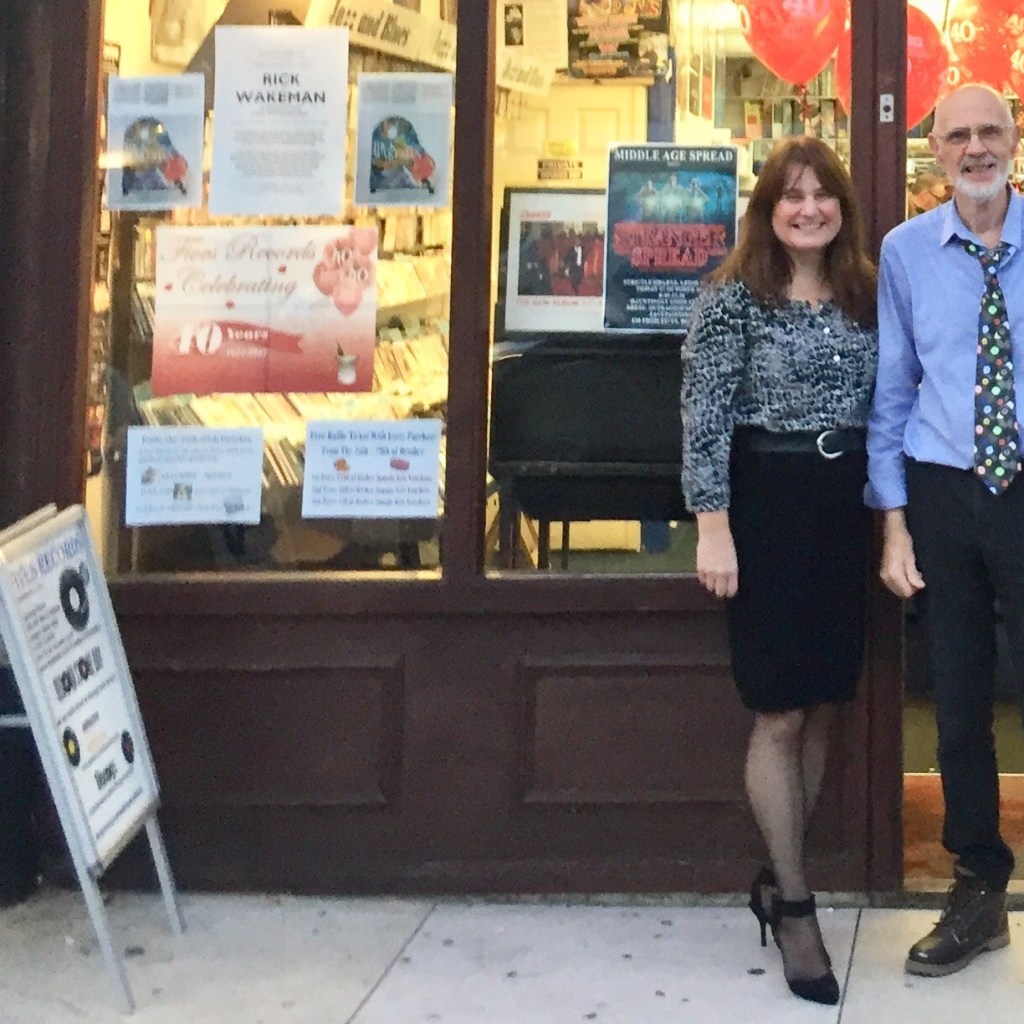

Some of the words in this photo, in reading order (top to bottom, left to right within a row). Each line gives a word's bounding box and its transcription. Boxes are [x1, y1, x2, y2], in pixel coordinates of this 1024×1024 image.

[950, 20, 976, 43] 40
[262, 72, 300, 87] RICK
[236, 90, 326, 104] WAKEMAN
[614, 149, 660, 162] MIDDLE
[662, 150, 687, 162] AGE
[689, 150, 734, 162] SPREAD
[226, 229, 316, 261] Records
[177, 266, 299, 302] Celebrating
[226, 326, 269, 342] Years
